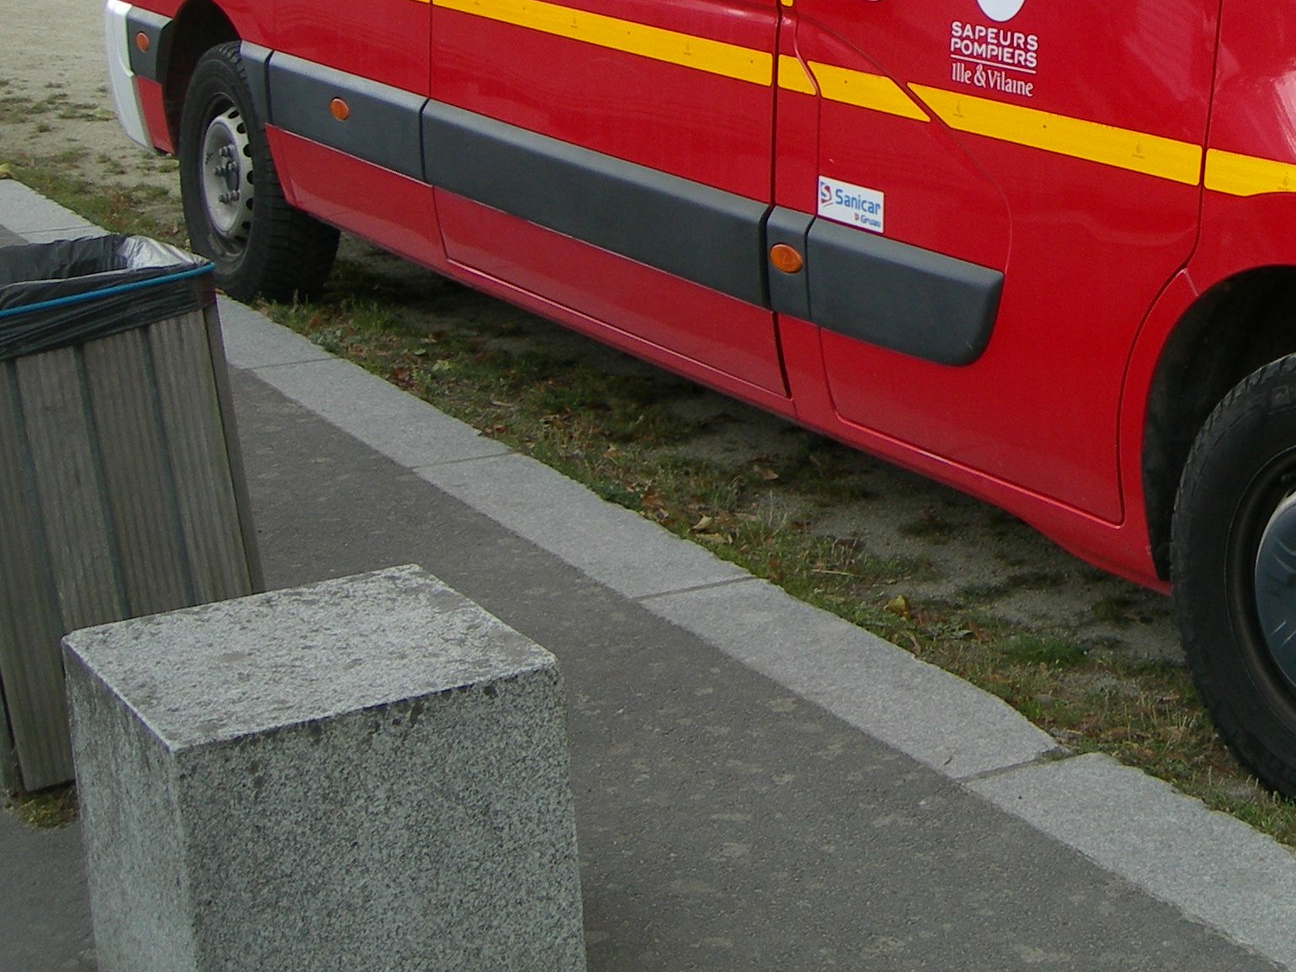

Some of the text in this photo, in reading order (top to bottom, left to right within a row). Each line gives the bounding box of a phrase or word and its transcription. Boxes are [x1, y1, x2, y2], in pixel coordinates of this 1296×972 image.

[951, 21, 1038, 51] SAPEURS
[951, 38, 1038, 68] POMPIERS
[952, 62, 1034, 97] Ille & Vilaine
[835, 188, 881, 215] Sanicar
